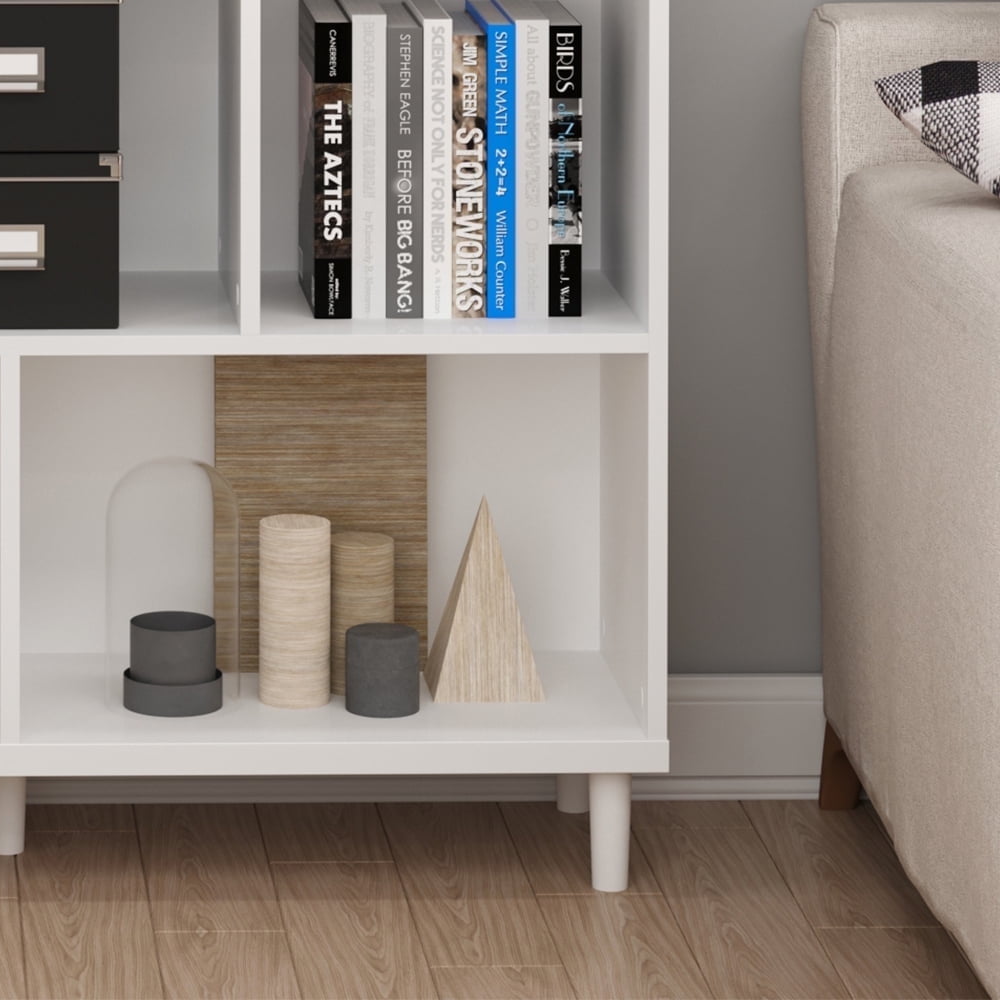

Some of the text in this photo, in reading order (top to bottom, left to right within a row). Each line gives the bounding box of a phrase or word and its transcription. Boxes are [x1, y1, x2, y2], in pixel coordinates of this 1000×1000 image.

[431, 26, 445, 86] SCIENCE
[527, 24, 540, 44] All
[399, 33, 411, 136] STEPHEN EAGLE
[462, 43, 478, 117] JIM GREEN
[495, 31, 508, 135] SIMPLE MATH
[527, 47, 540, 85] about
[555, 32, 574, 93] BIRDS
[431, 88, 445, 124] NOT
[557, 103, 575, 118] of
[324, 100, 343, 241] THE AZTECS
[431, 127, 445, 176] ONLY
[495, 148, 508, 196] 2+2=4
[431, 177, 445, 211] FOR
[454, 127, 484, 312] STONEWORKS
[397, 149, 413, 313] BEFORE BIG BANG!
[431, 213, 445, 263] NERDS
[495, 210, 507, 311] William Counter
[559, 274, 571, 283] J.
